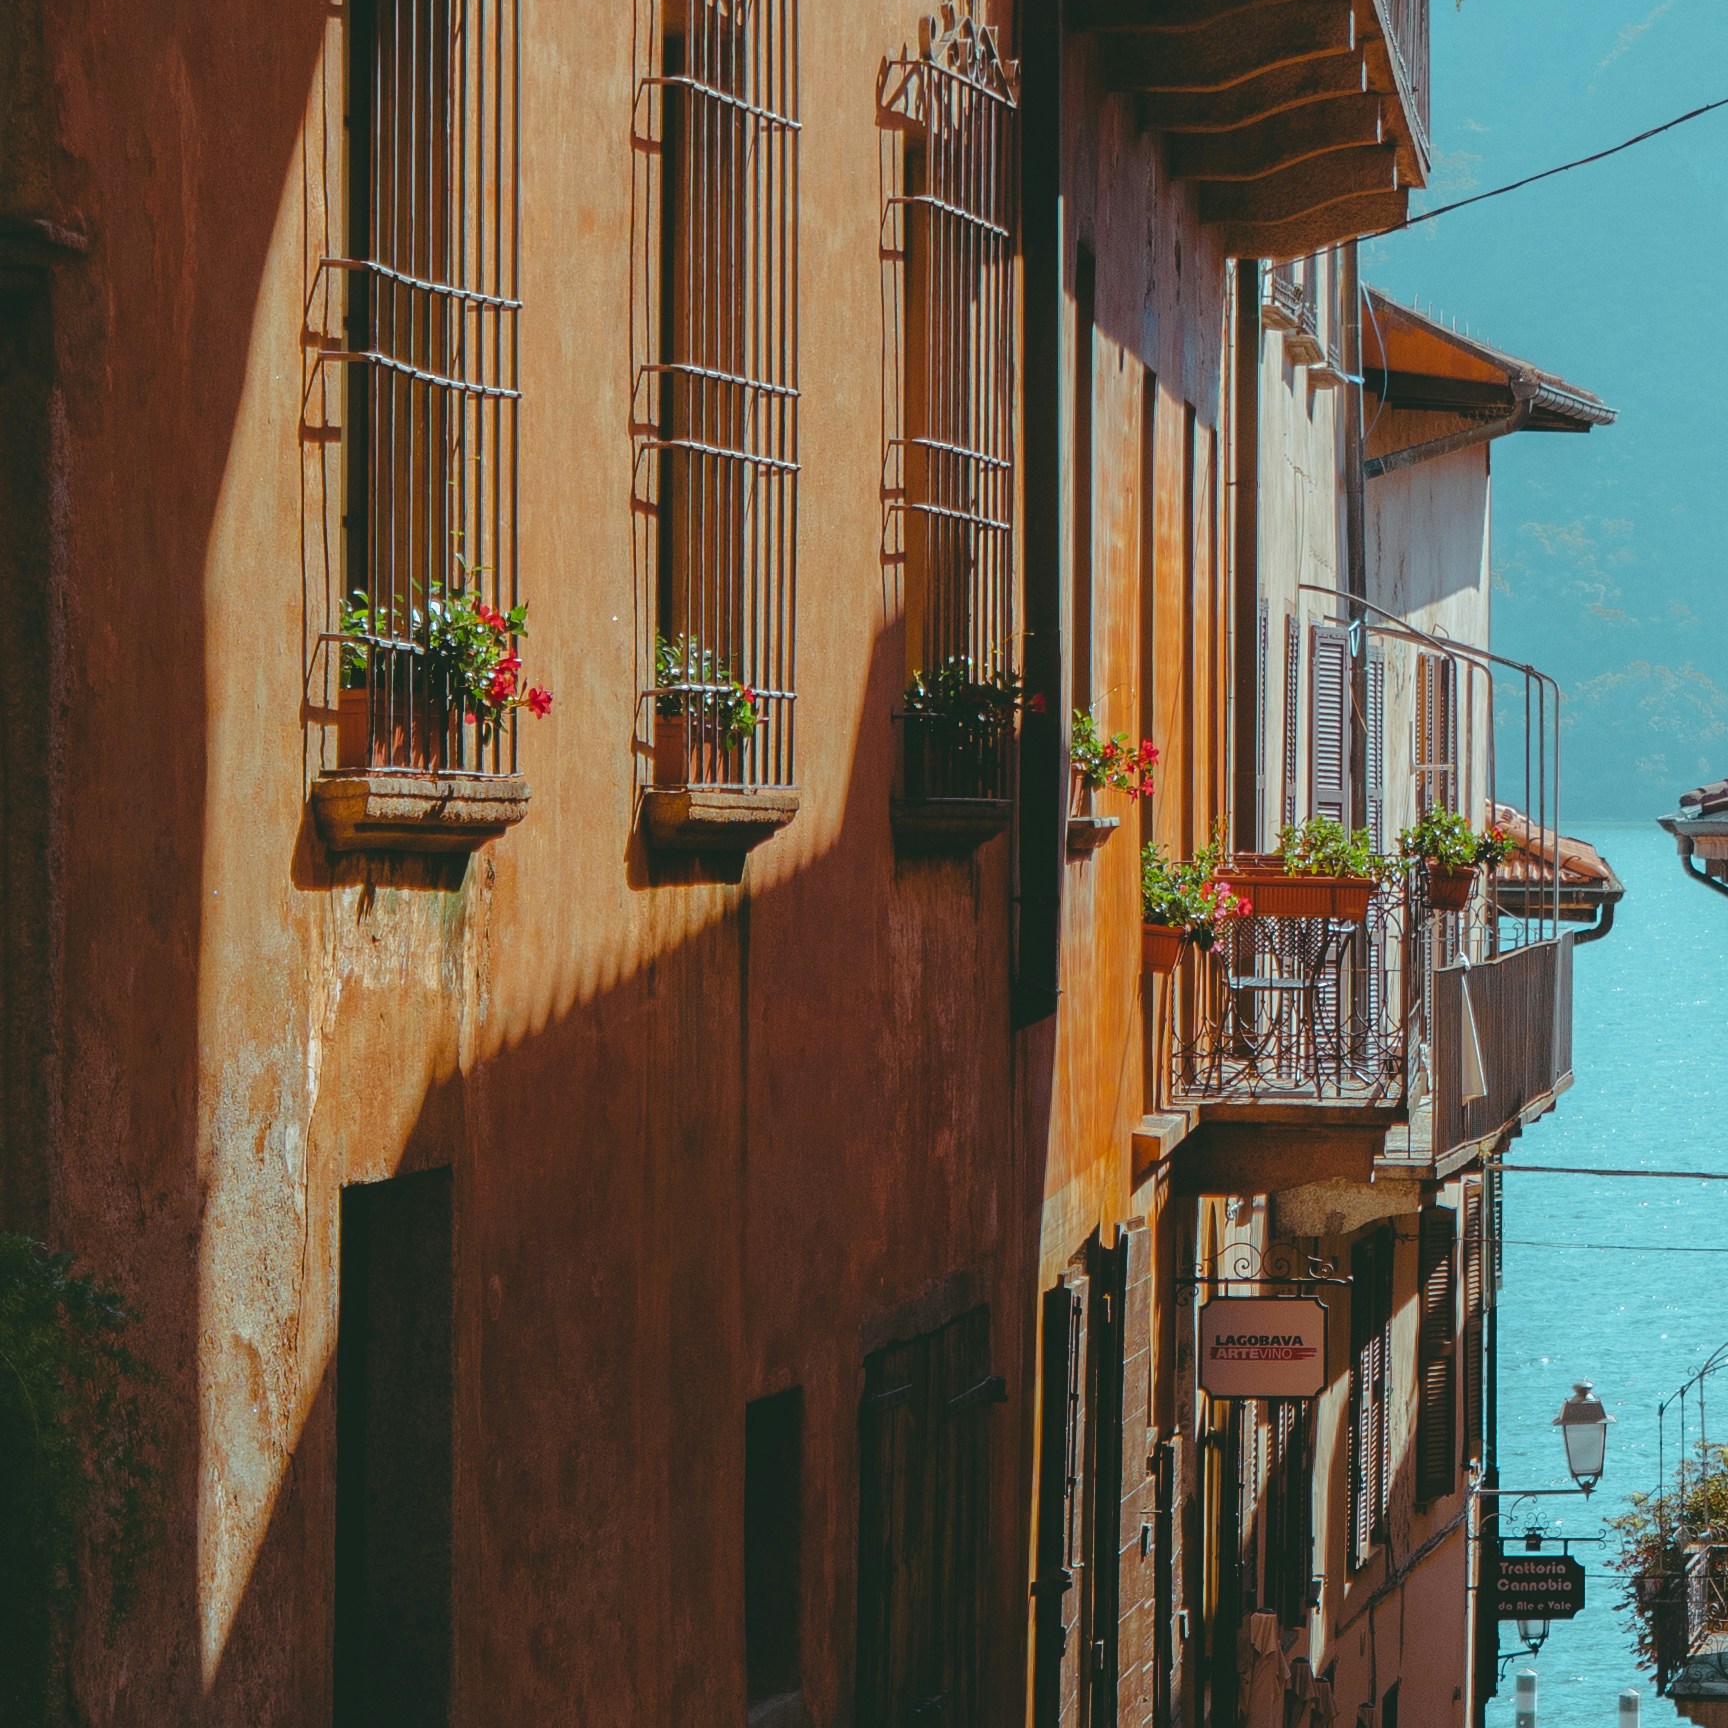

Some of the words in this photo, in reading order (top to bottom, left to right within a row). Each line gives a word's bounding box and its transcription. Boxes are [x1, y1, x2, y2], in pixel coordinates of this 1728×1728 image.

[1215, 1335, 1304, 1346] LAGOBAVA
[1216, 1348, 1293, 1360] ARTEVINO
[1499, 1561, 1566, 1574] Trattoria
[1497, 1578, 1572, 1591] Cannobio
[1498, 1601, 1513, 1611] da
[1516, 1601, 1534, 1611] Ale
[1537, 1603, 1544, 1611] e
[1547, 1601, 1572, 1611] Vale
